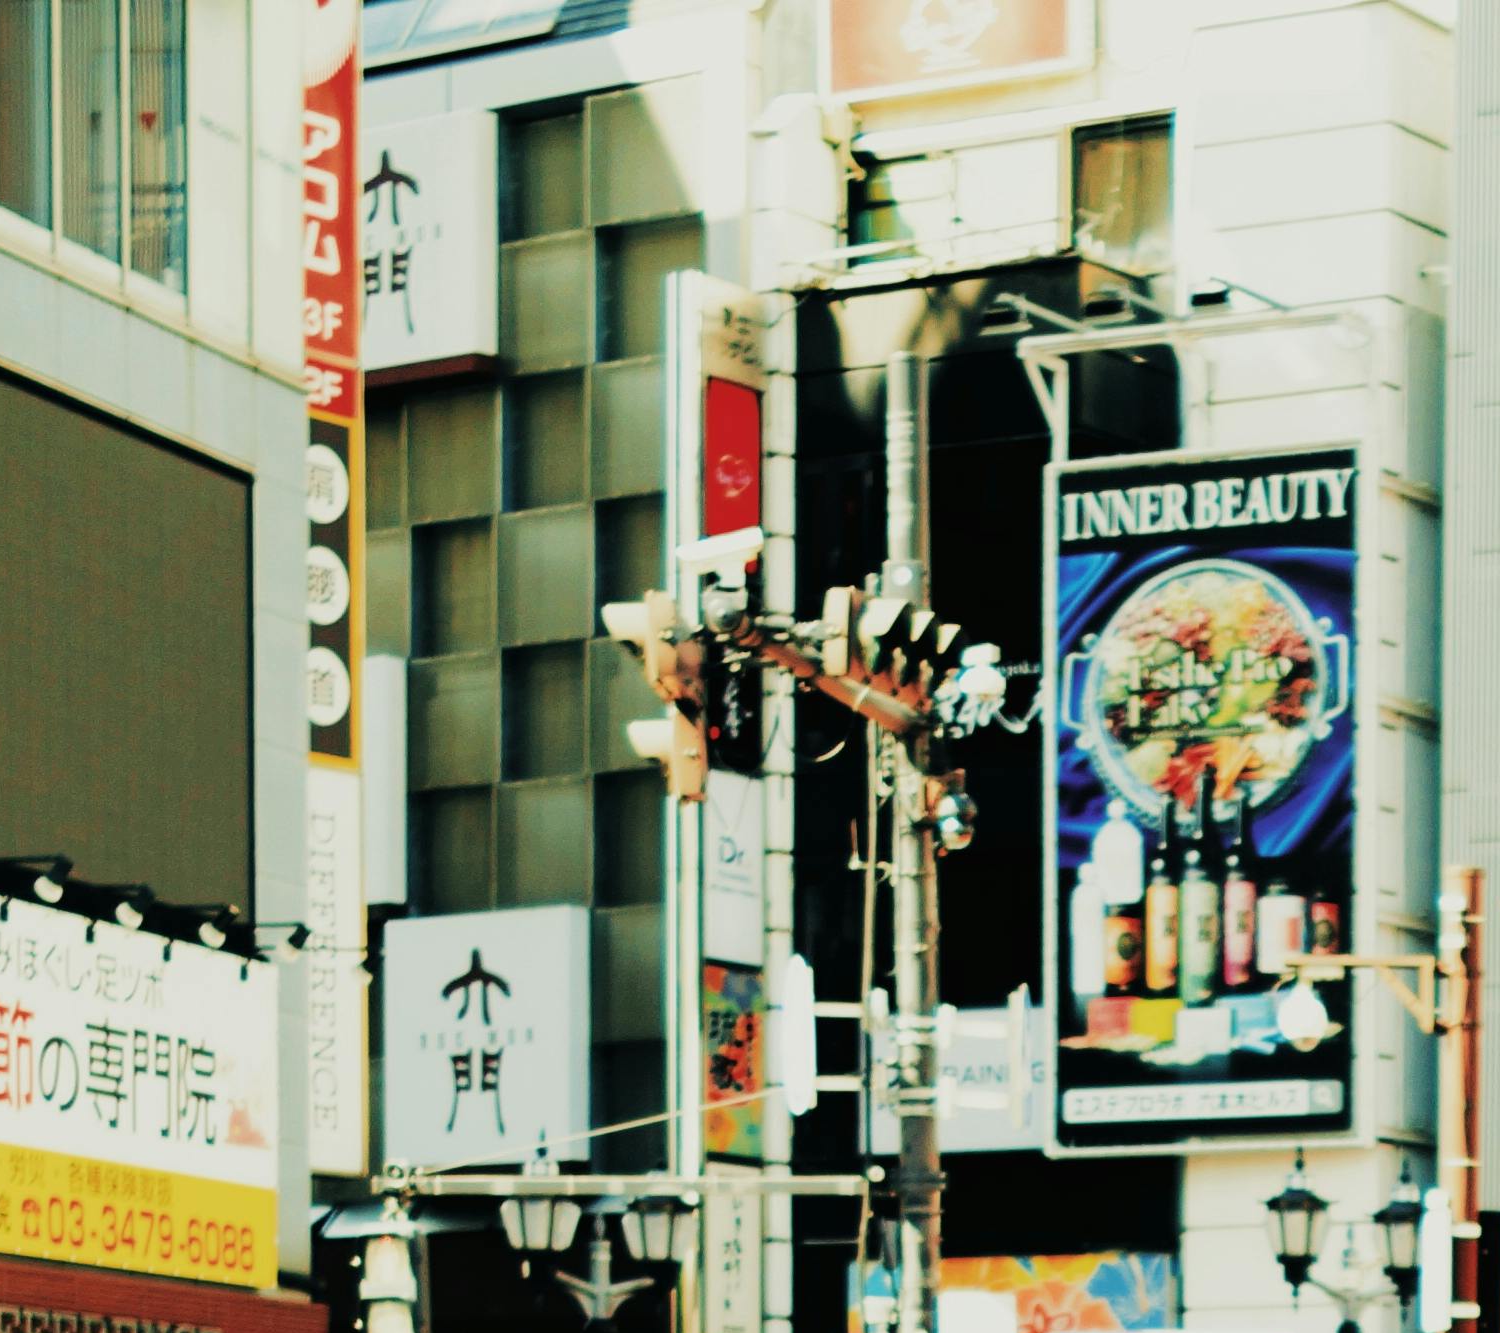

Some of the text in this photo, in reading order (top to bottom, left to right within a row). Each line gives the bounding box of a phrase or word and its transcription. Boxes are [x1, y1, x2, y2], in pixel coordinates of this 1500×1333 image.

[303, 108, 341, 276] アコム
[303, 297, 344, 343] 3F
[1061, 467, 1356, 542] INNER BEAUTY
